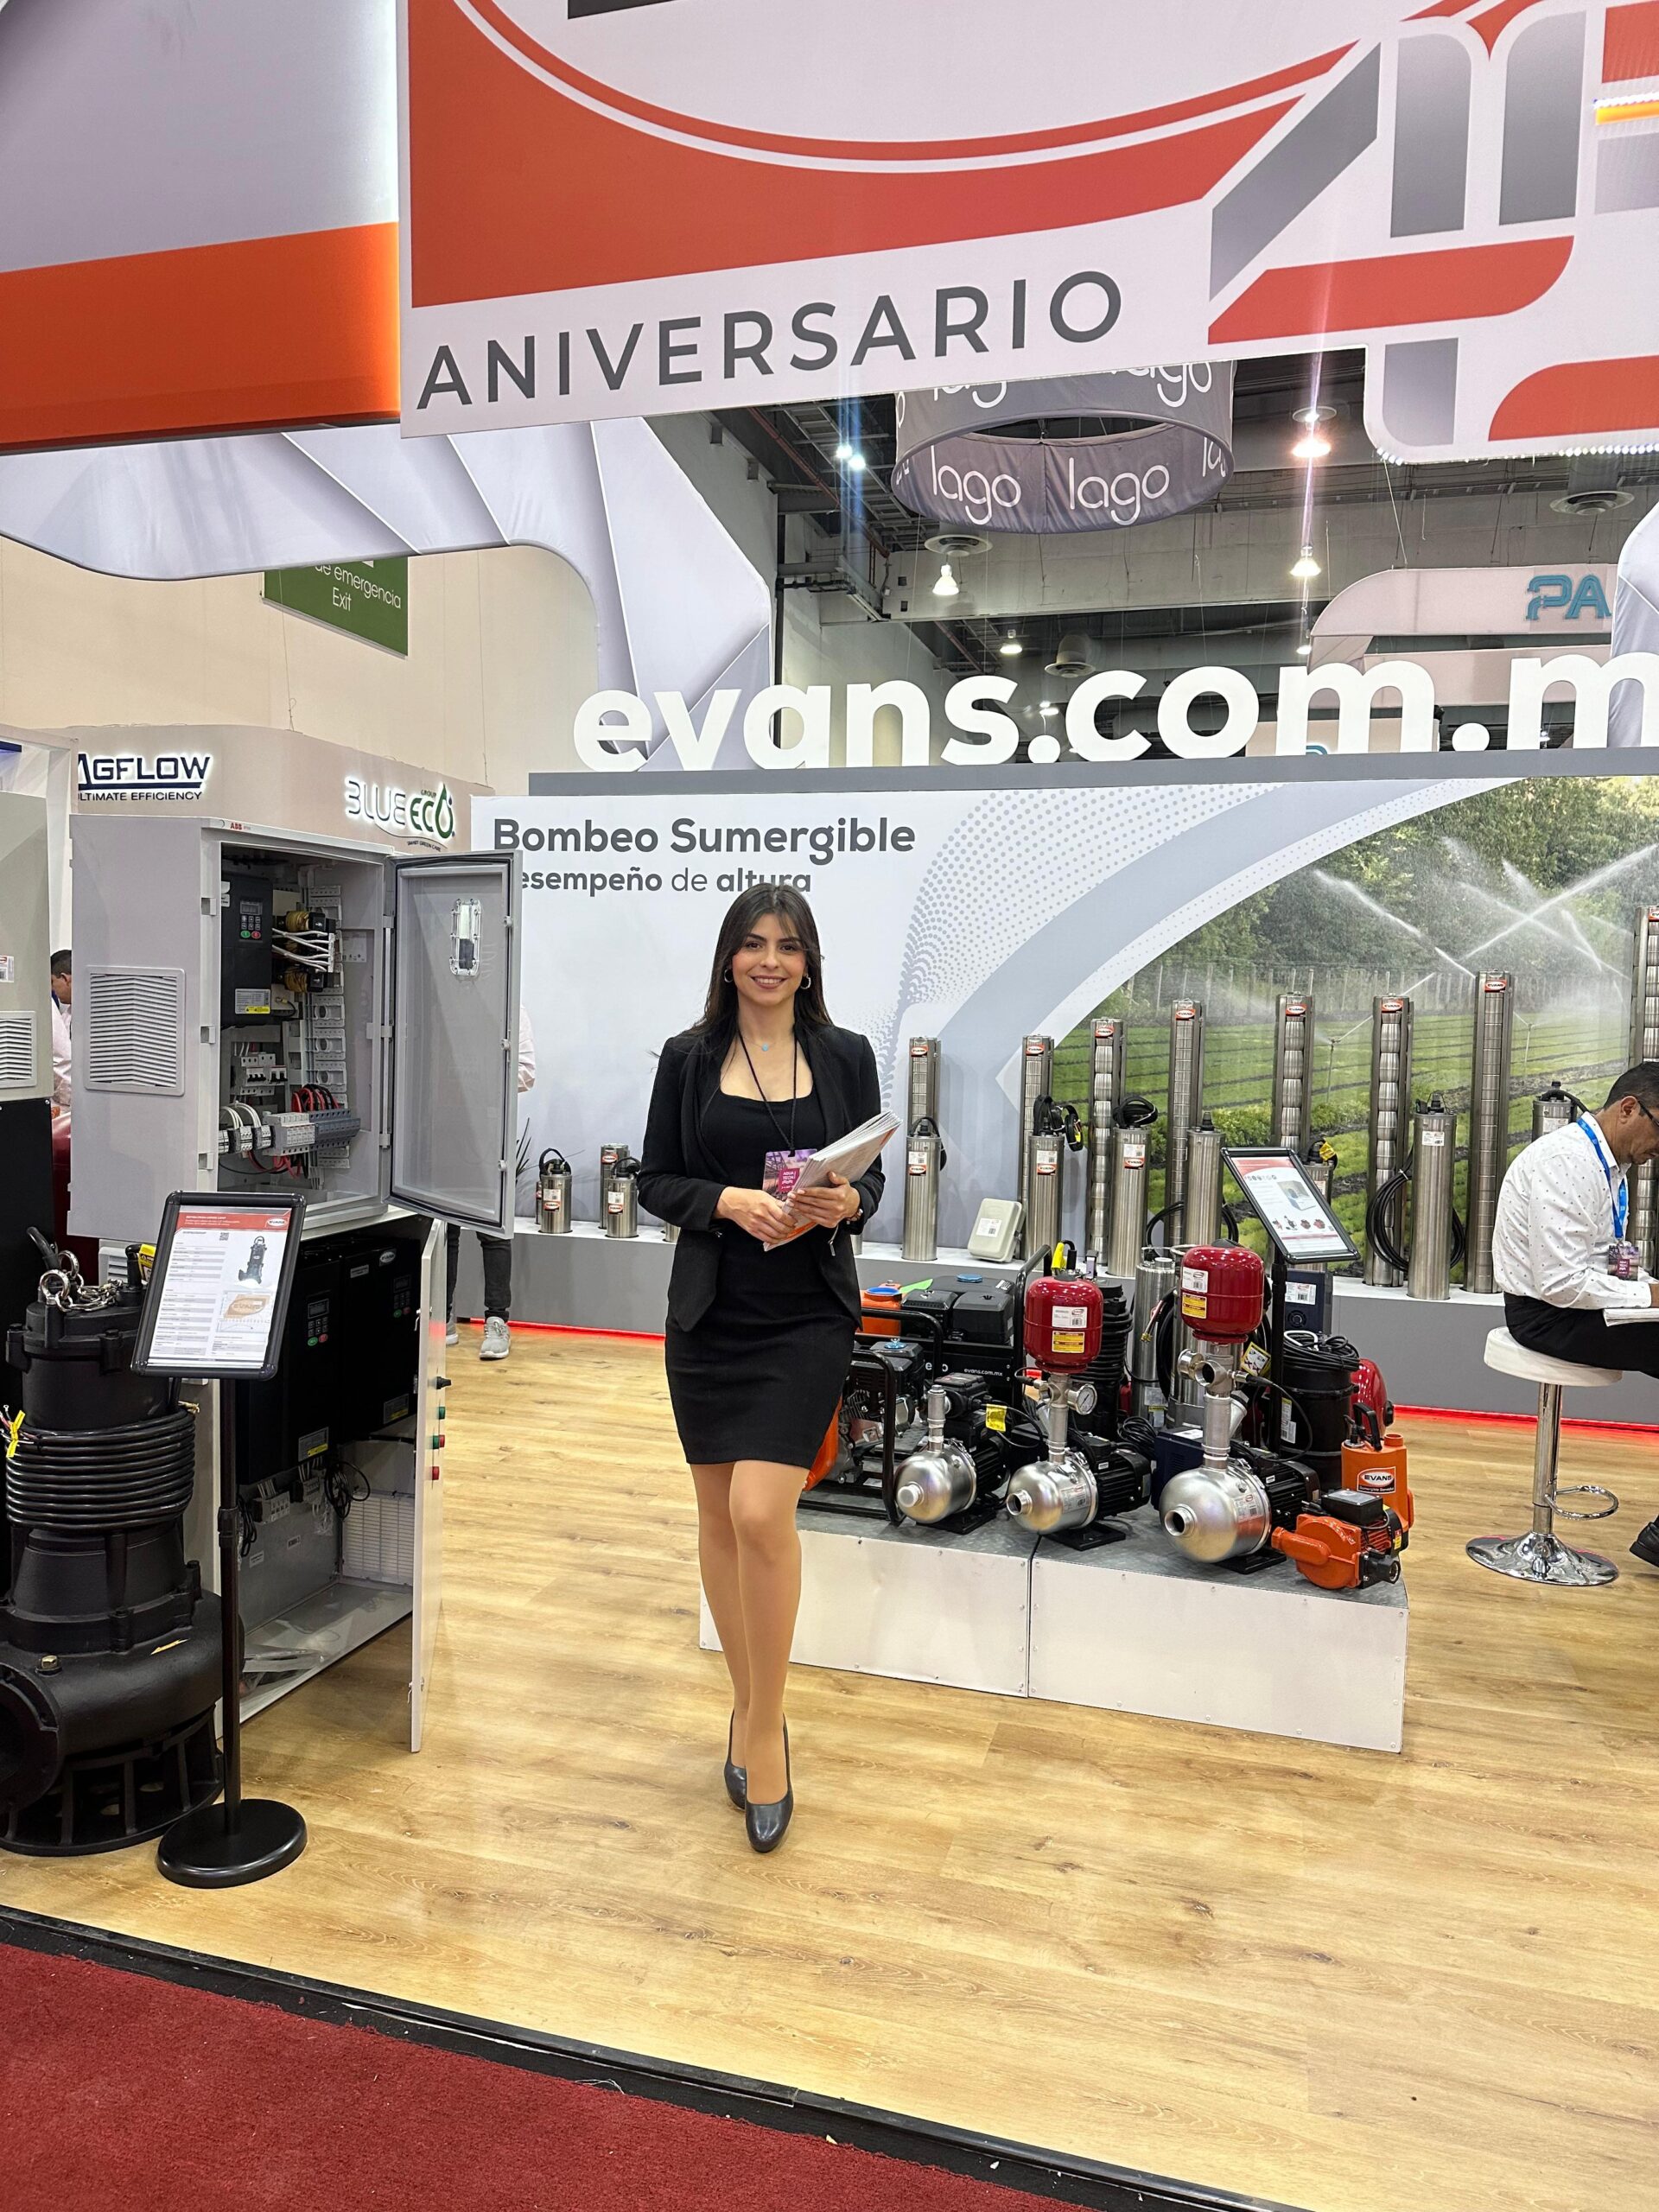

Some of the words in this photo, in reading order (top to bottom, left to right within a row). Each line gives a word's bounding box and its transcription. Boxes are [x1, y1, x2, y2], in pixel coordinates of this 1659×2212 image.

[416, 270, 1122, 410] ANIVERSARIO
[931, 444, 1021, 525] lago
[1069, 457, 1170, 526] lago
[333, 587, 352, 612] Exit
[334, 566, 402, 609] emergencia
[574, 652, 1659, 772] evans.com.m
[78, 792, 127, 801] LTIMATE
[130, 791, 203, 801] EFFICIENCY
[493, 817, 658, 853] Bombeo
[670, 817, 916, 866] Sumergible
[671, 867, 708, 892] de
[963, 1368, 1003, 1377] evans.com.mx
